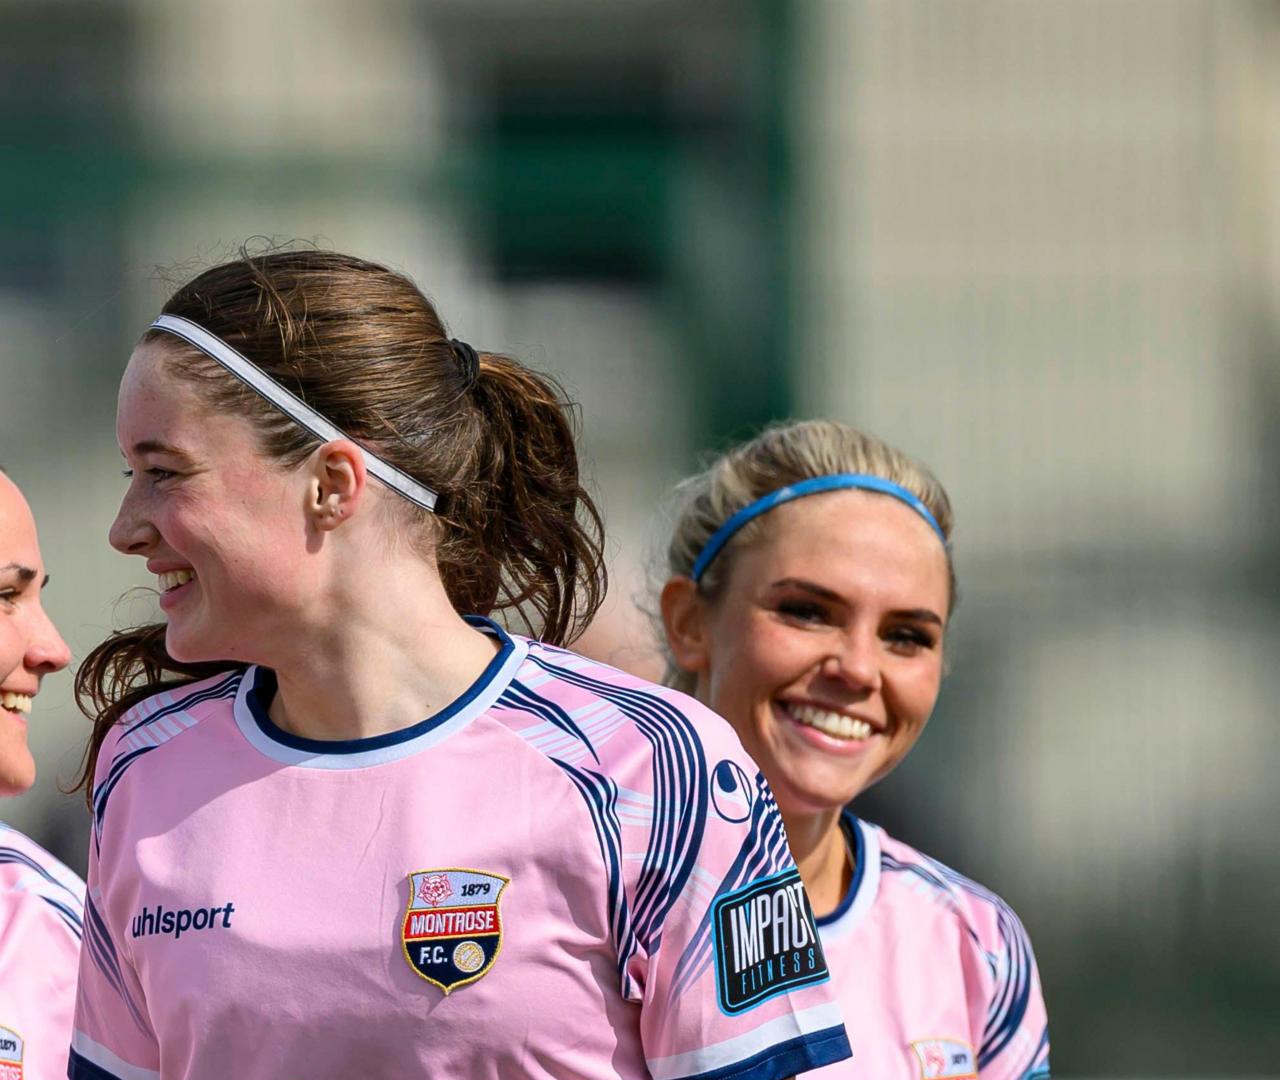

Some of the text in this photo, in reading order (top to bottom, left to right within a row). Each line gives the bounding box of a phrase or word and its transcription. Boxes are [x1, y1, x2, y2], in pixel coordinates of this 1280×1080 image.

[461, 883, 491, 897] 1879
[132, 902, 235, 939] uhlsport
[409, 911, 494, 936] MONTROSE
[730, 881, 816, 974] IMPACT
[420, 945, 448, 965] F.C.
[742, 947, 815, 995] FITNESS
